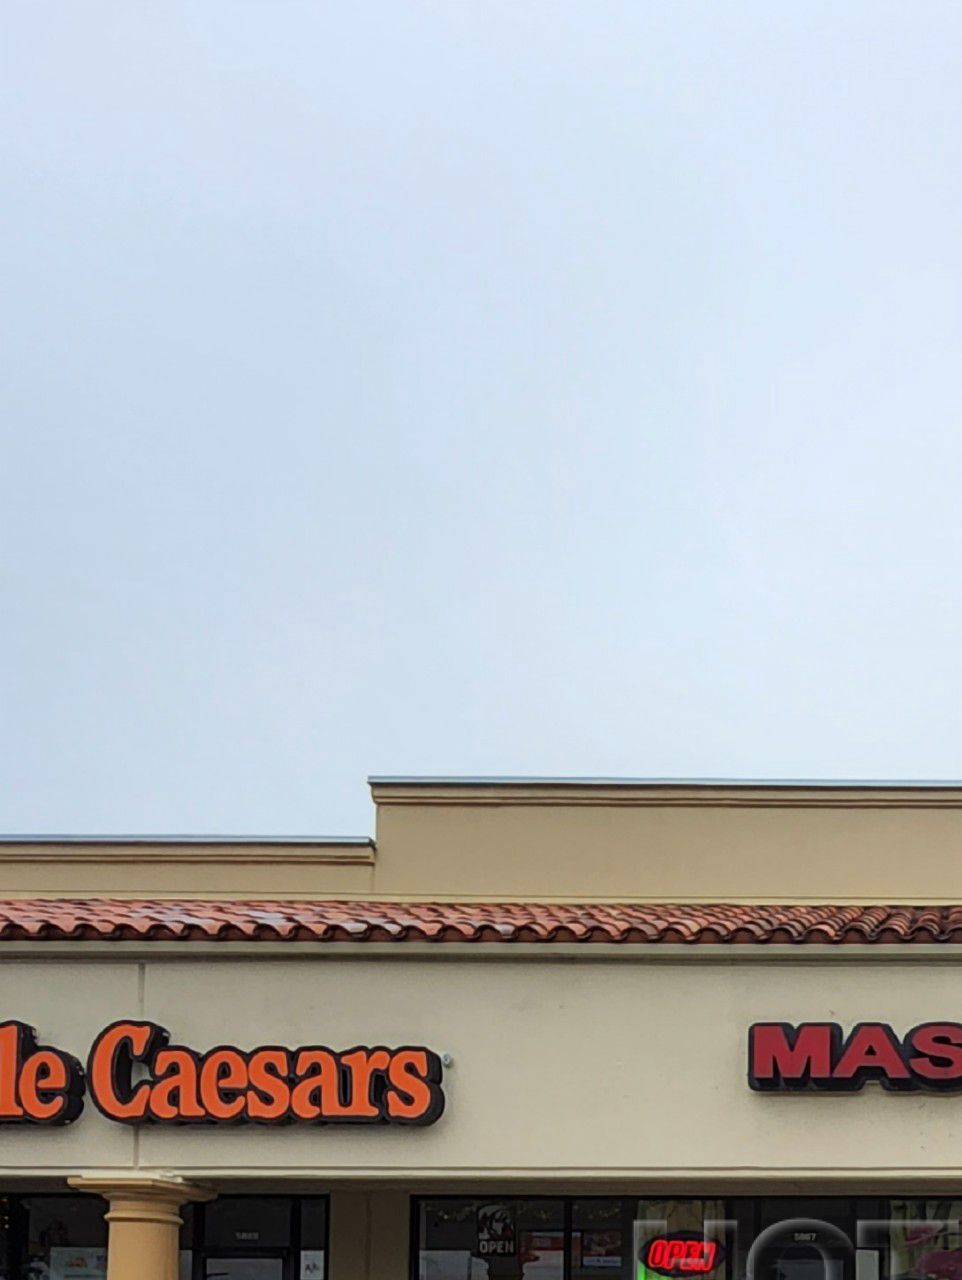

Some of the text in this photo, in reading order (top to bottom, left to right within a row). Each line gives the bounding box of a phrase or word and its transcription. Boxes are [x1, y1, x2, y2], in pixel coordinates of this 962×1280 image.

[87, 1020, 444, 1127] Caesars
[479, 1240, 515, 1254] OPEN
[649, 1240, 716, 1270] OPEN
